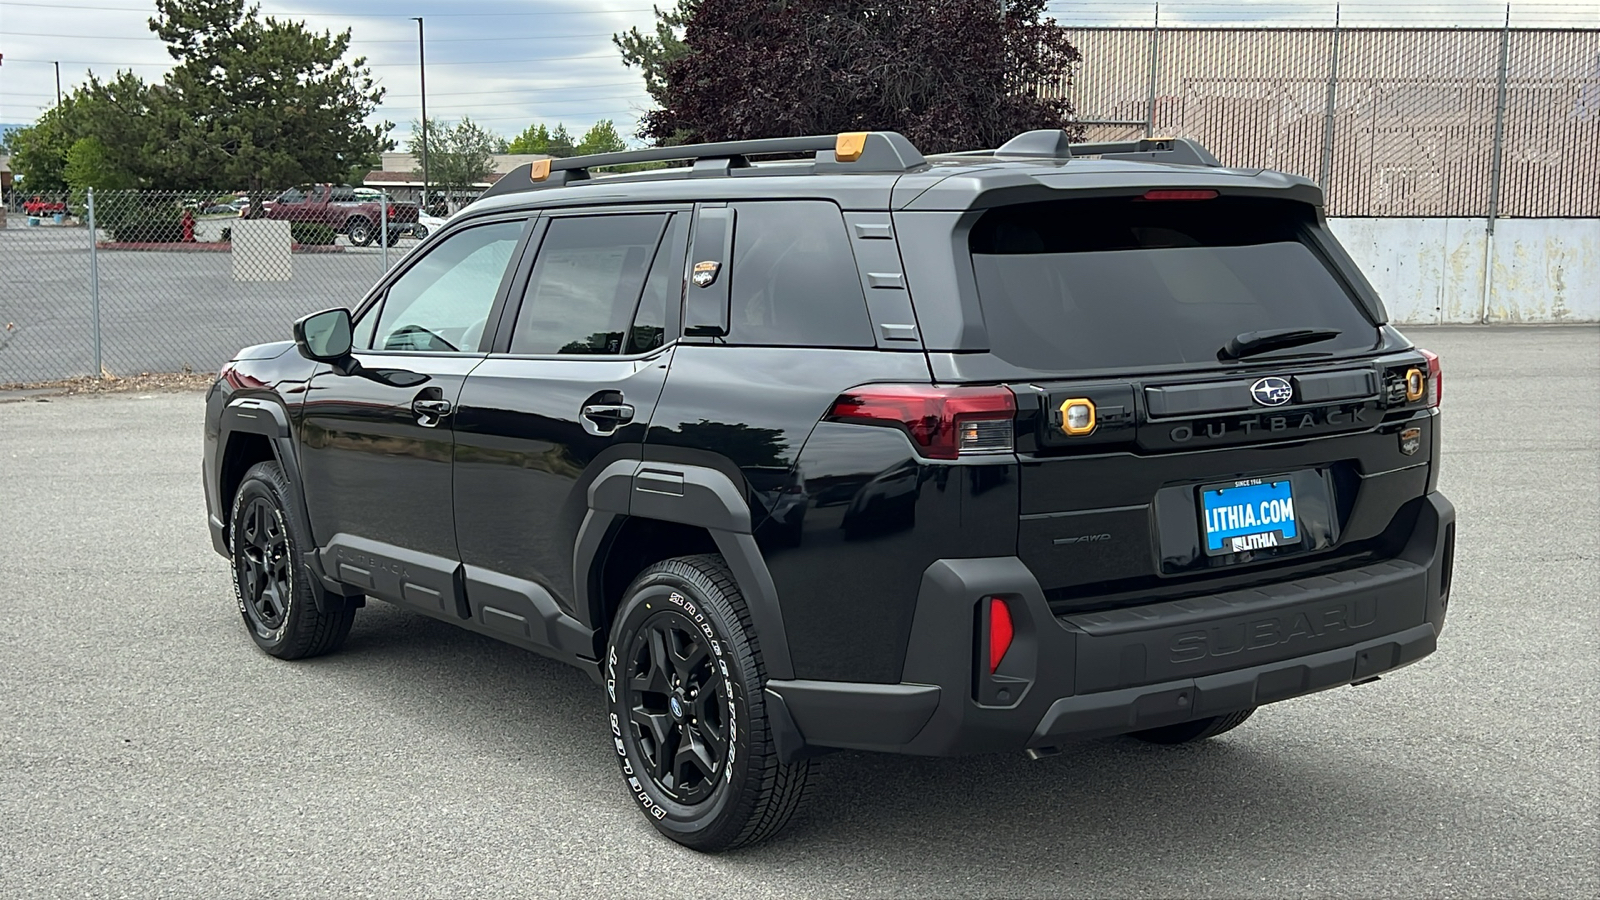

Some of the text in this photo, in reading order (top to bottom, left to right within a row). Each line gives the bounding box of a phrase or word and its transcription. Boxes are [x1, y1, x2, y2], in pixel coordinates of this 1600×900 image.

[1169, 407, 1366, 443] OUTBACK
[1234, 480, 1250, 488] SINCE
[1205, 497, 1295, 533] LITHIA.COM
[1077, 533, 1112, 543] AWD
[1242, 531, 1278, 551] LITHIA
[1170, 596, 1378, 664] SUBARU
[609, 712, 668, 820] DUELER
